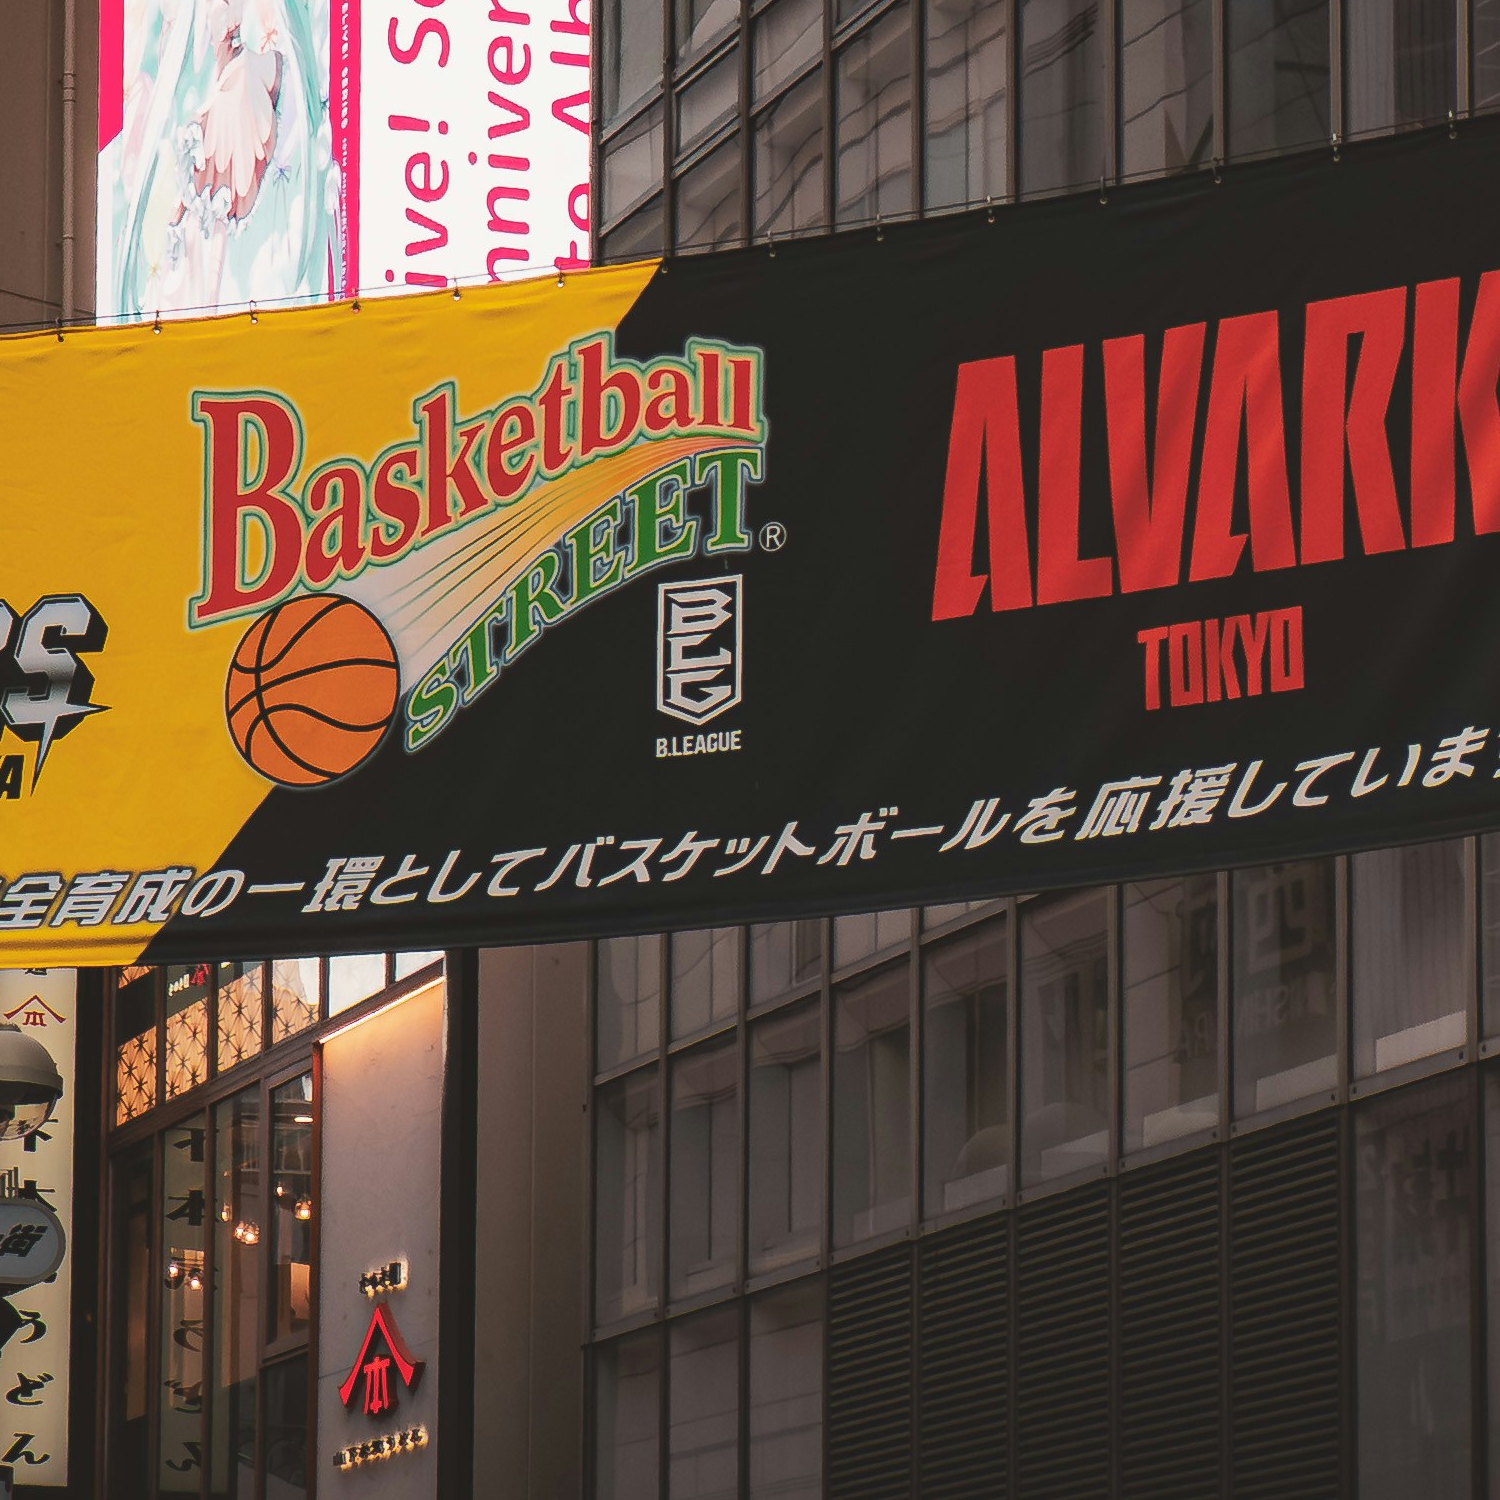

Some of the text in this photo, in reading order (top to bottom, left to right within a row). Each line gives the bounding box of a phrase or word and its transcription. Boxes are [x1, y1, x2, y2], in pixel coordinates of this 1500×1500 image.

[188, 329, 769, 631] Basketball
[404, 444, 767, 753] STREET
[1137, 605, 1304, 710] TOKYO
[655, 730, 742, 757] B.LEAGUE
